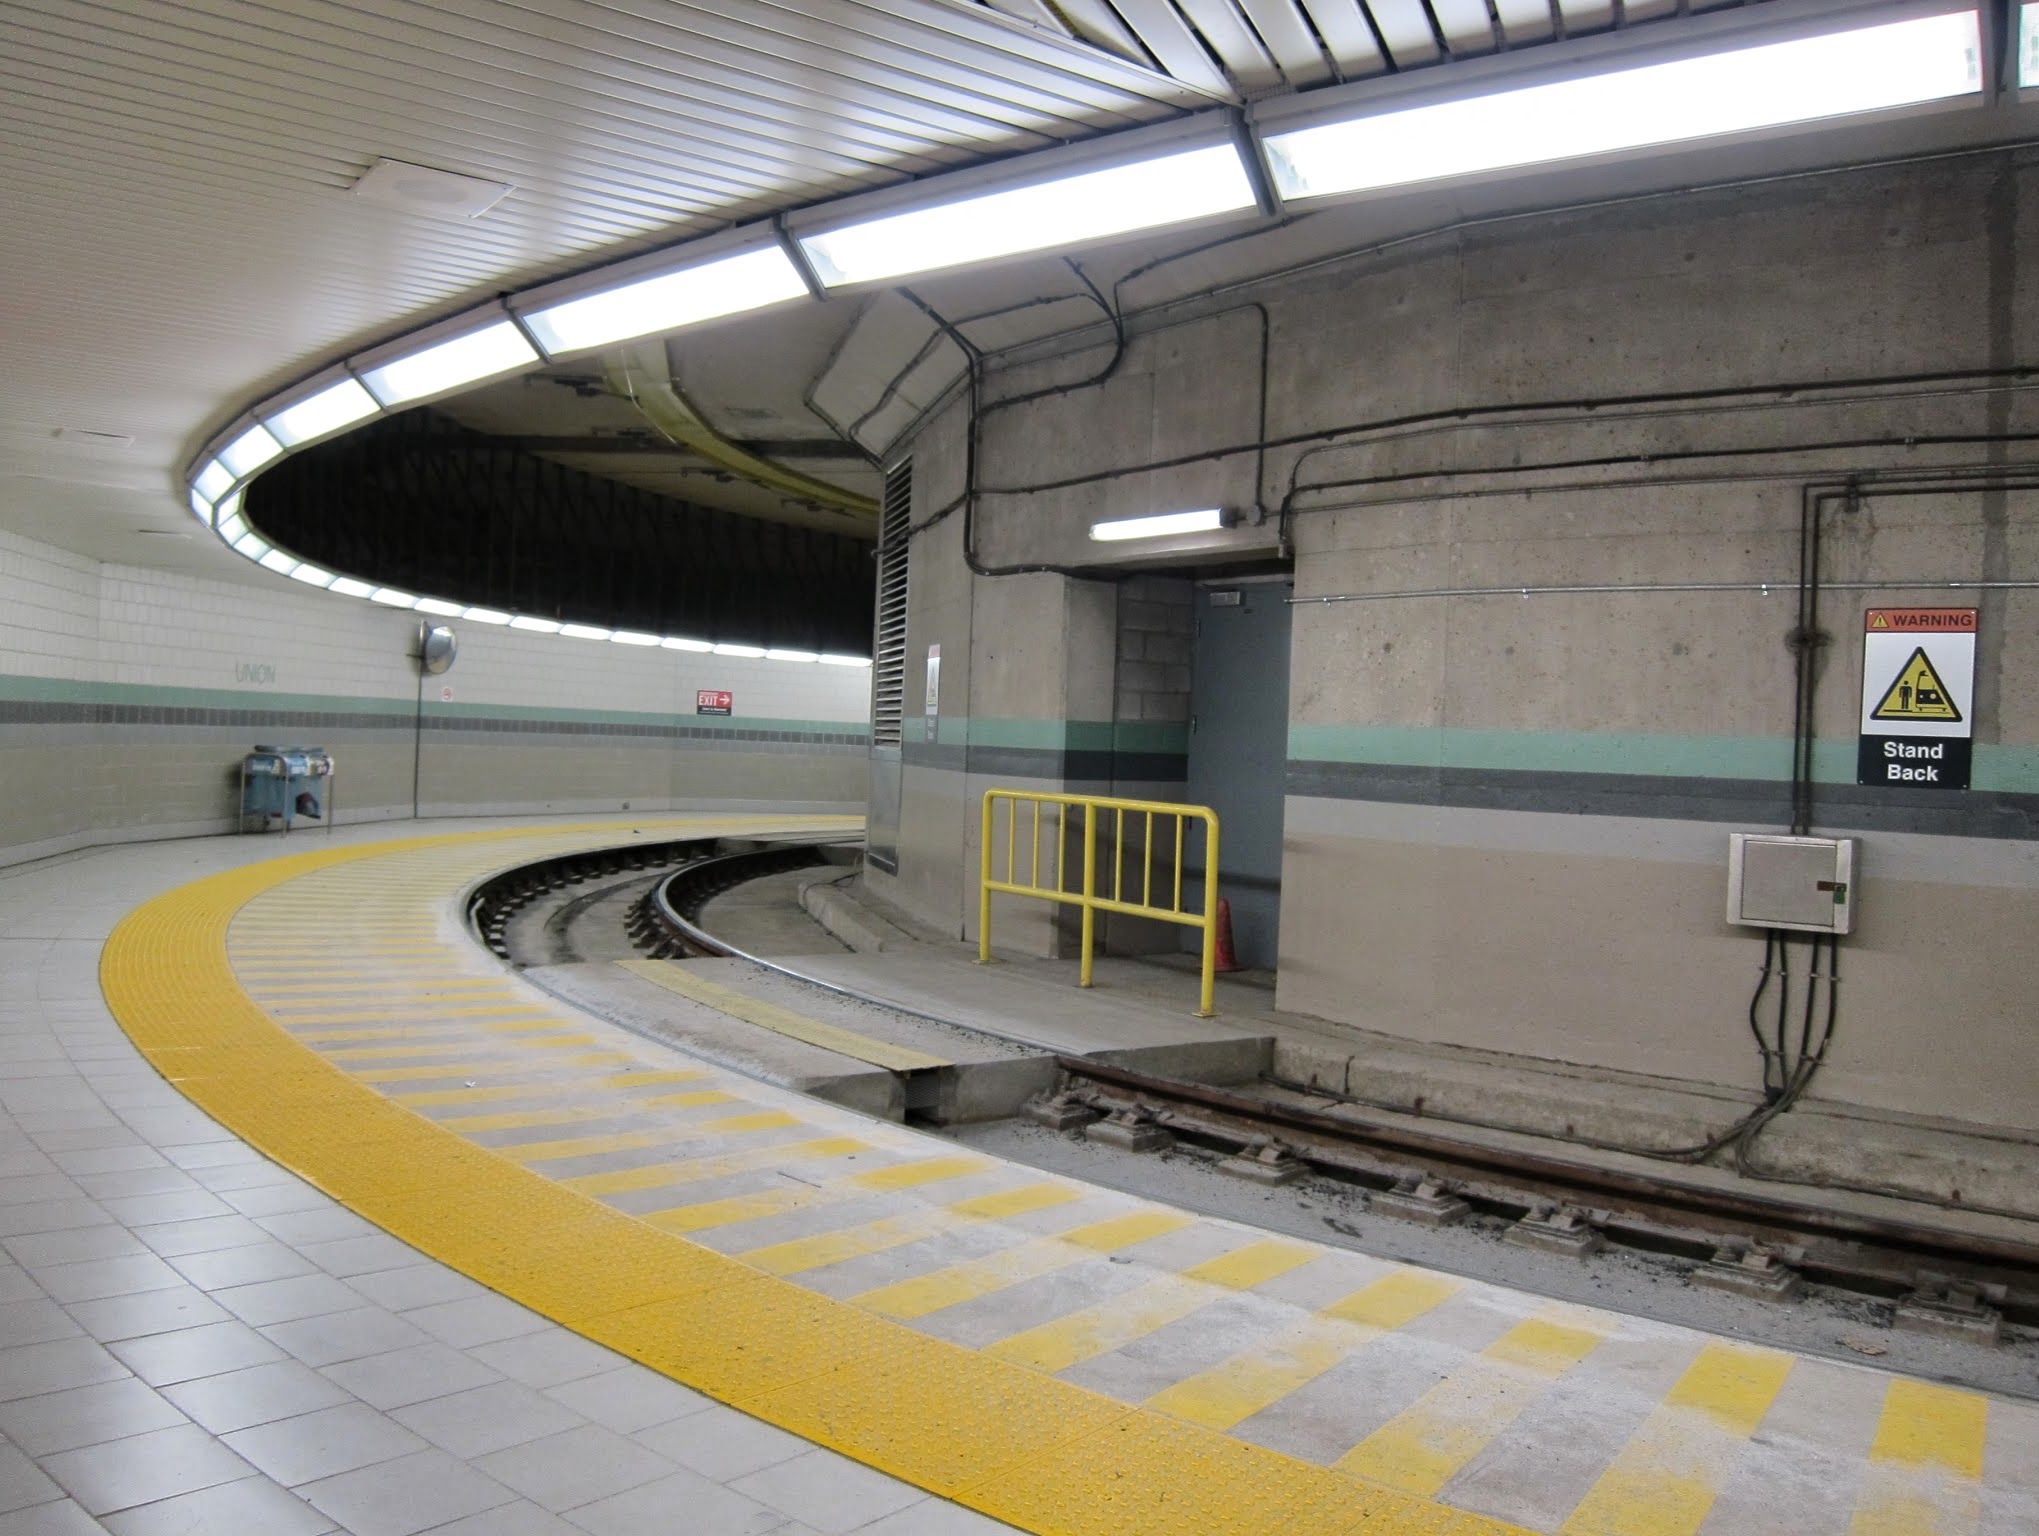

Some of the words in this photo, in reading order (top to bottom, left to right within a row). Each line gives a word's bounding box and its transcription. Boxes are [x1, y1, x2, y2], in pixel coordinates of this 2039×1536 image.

[1893, 614, 1972, 627] WARNING
[234, 661, 276, 685] UNION
[699, 695, 718, 706] EXIT
[1884, 741, 1943, 760] Stand
[1887, 763, 1939, 782] Back
